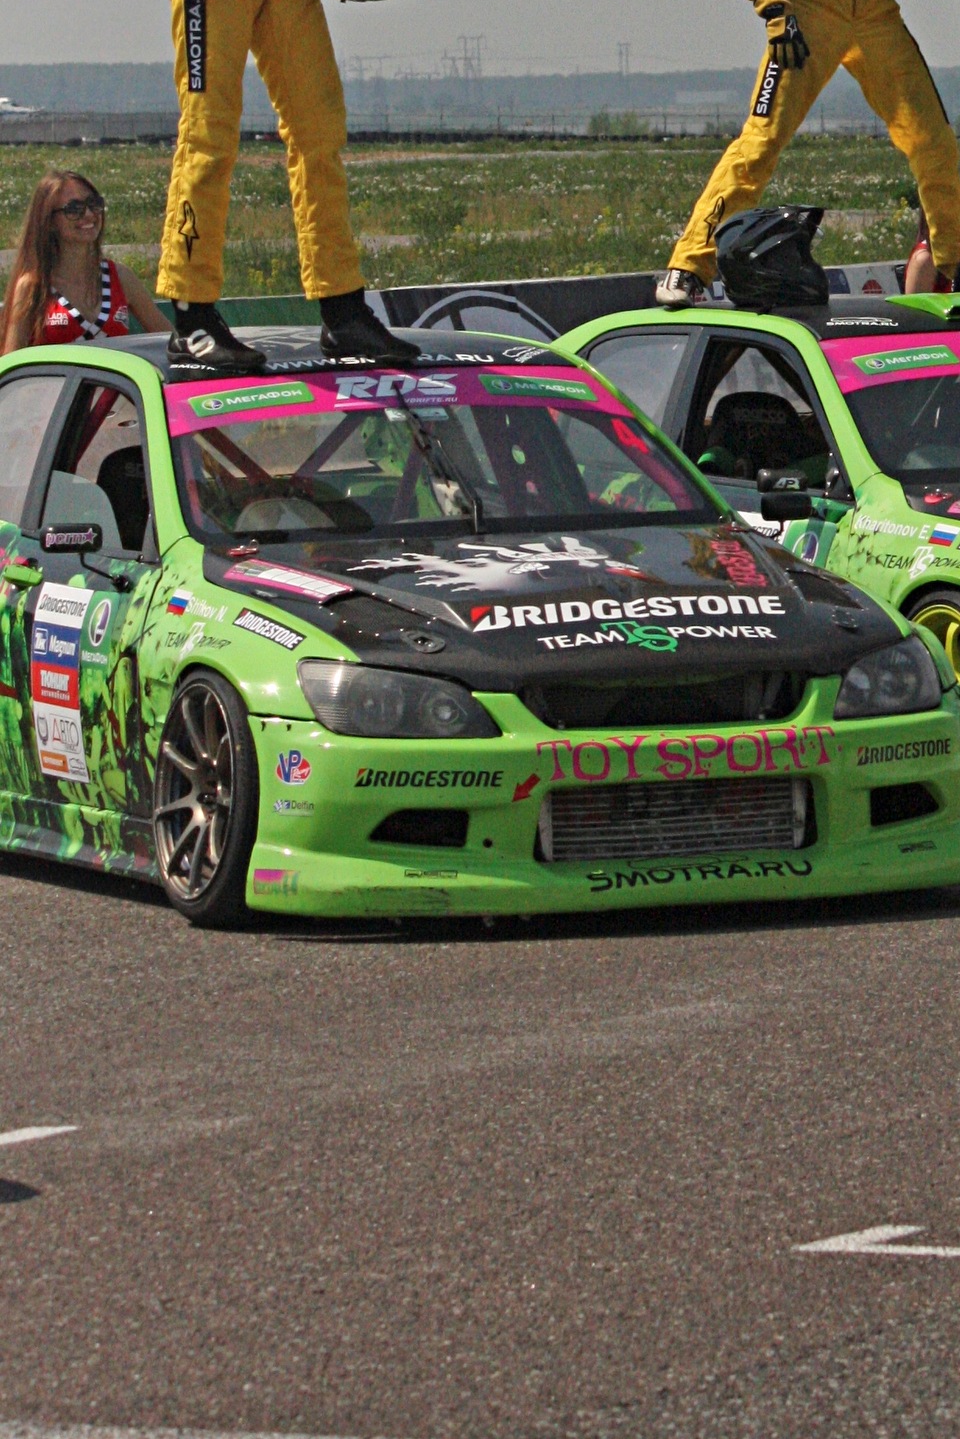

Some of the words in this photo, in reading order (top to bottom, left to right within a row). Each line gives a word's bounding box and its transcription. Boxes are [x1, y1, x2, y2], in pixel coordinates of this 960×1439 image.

[47, 312, 69, 320] LADA
[826, 320, 900, 328] SMOTRA.RU
[334, 373, 459, 401] RDS
[611, 418, 651, 455] 4
[855, 515, 917, 538] Kharitonov
[917, 524, 930, 540] E.
[883, 553, 914, 570] TEAM
[38, 593, 88, 618] BRIDGESTONE
[470, 595, 786, 633] BRIDGESTONE
[234, 610, 303, 649] BRIDGESTONE
[537, 631, 624, 650] TEAM
[665, 625, 777, 640] POWER
[856, 738, 952, 767] BRIDGESTONE
[355, 767, 504, 788] BRIDGESTONE
[291, 799, 315, 810] Delfin
[586, 860, 814, 893] SMOTRA.RU
